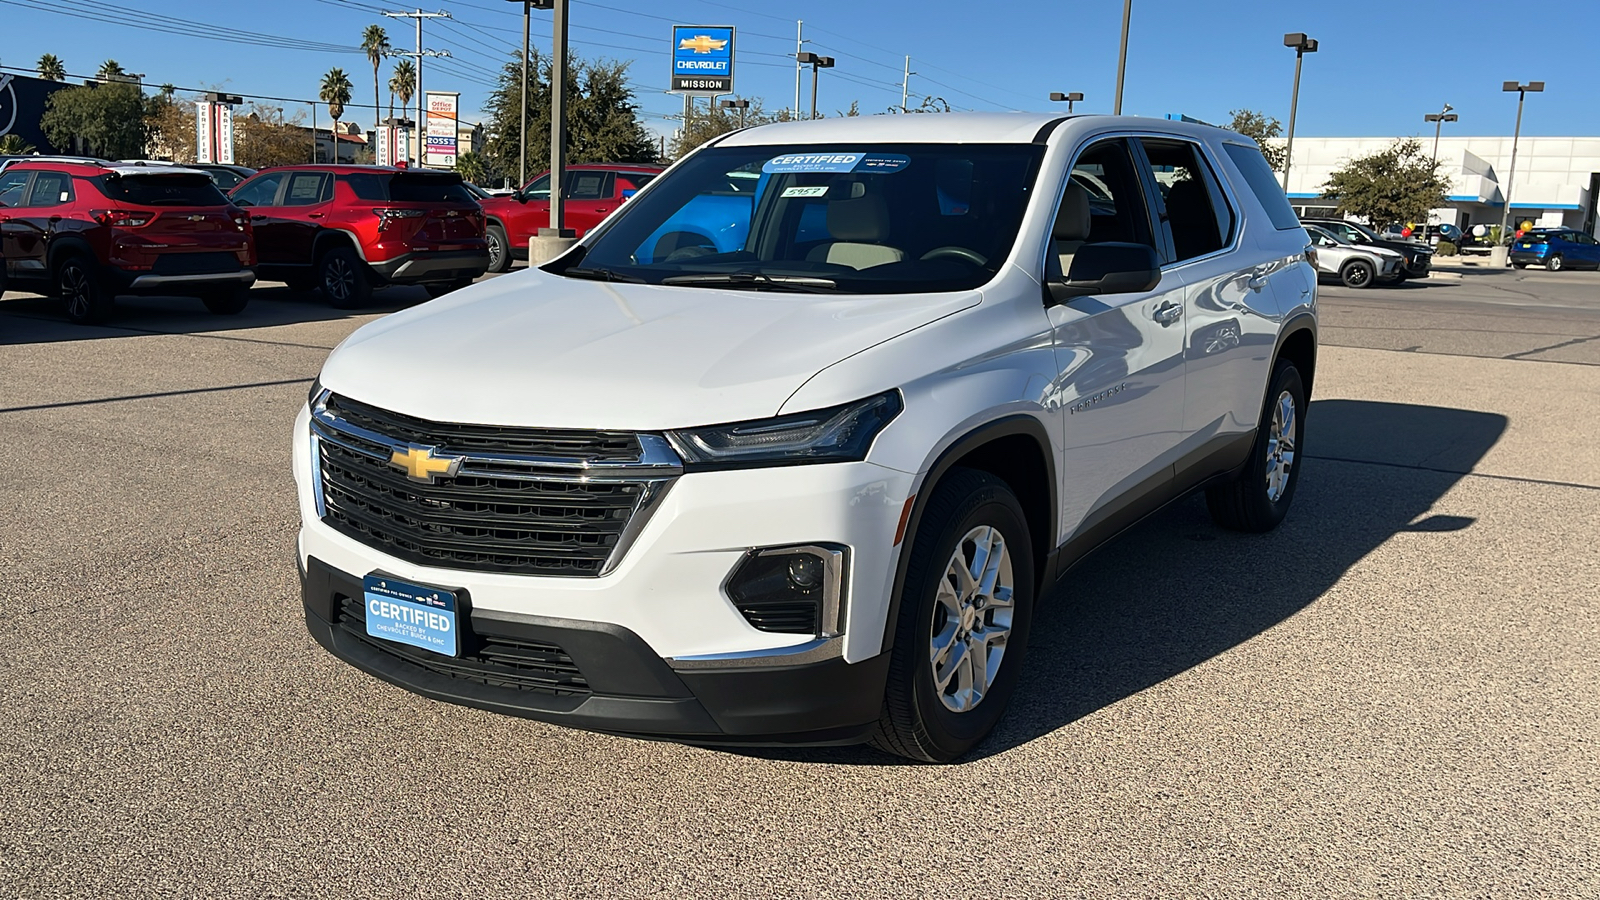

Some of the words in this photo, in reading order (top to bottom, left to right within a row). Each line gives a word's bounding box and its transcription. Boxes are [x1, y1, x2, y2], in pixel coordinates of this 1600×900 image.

[677, 60, 727, 70] CHEVROLET
[681, 80, 722, 89] MISSION
[427, 137, 449, 145] ROSS
[771, 155, 857, 165] CERTIFIED
[786, 187, 821, 196] 5957
[1070, 381, 1127, 415] TRAVERSE
[369, 599, 450, 632] CERTIFIED
[395, 622, 417, 633] BACKED
[418, 627, 426, 635] BY
[376, 624, 409, 636] CHEVROLET
[410, 631, 427, 641] BUICK
[432, 638, 445, 646] GMC
